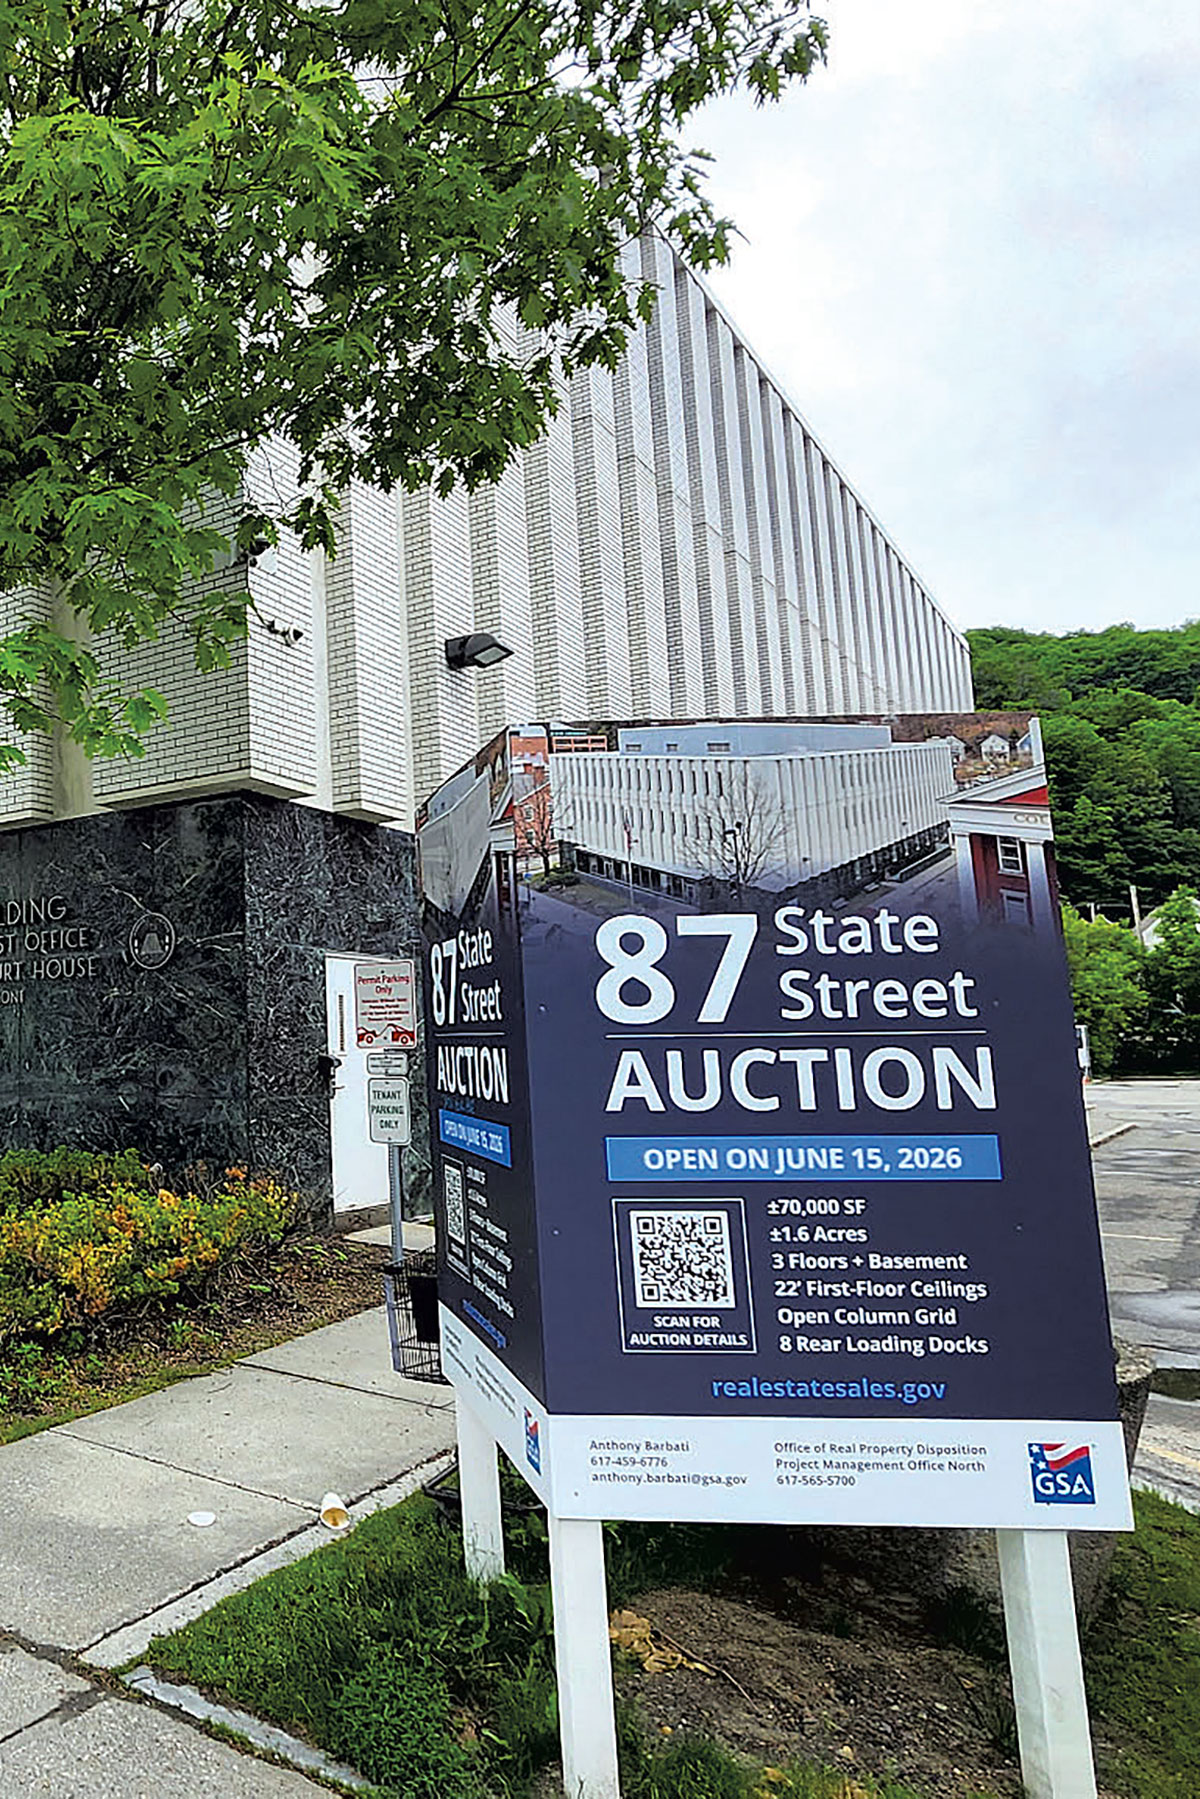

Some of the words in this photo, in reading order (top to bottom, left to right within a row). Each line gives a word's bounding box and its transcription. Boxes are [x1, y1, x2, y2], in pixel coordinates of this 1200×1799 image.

[25, 927, 90, 952] OFFICE
[773, 905, 940, 955] State
[457, 926, 493, 970] State
[32, 956, 98, 980] HOUSE
[595, 912, 759, 1025] 87
[357, 975, 381, 985] Permit
[382, 974, 410, 985] Parking
[430, 937, 458, 1027] 87
[375, 985, 393, 996] Only
[460, 979, 503, 1023] Street
[778, 969, 979, 1020] Street
[436, 1045, 510, 1104] AUCTION
[604, 1045, 998, 1112] AUCTION
[372, 1089, 402, 1100] TENANT
[371, 1105, 404, 1115] PARKING
[379, 1119, 399, 1129] ONLY
[643, 1148, 718, 1171] OPEN
[726, 1148, 770, 1171] ON
[774, 1148, 844, 1175] JUNE
[852, 1148, 891, 1174] 15,
[896, 1147, 963, 1170] 2026
[766, 1198, 841, 1219] ±70,000
[843, 1198, 867, 1216] SF
[768, 1225, 810, 1243] ±1.6
[812, 1225, 869, 1243] Acres
[771, 1252, 785, 1270] 3
[788, 1252, 849, 1270] Floors
[851, 1255, 865, 1269] +
[868, 1252, 968, 1270] Basement
[806, 1279, 906, 1299] First-Floor
[909, 1279, 988, 1301] Ceilings
[653, 1316, 691, 1329] SCAN
[693, 1316, 721, 1329] FOR
[777, 1307, 830, 1329] Open
[834, 1306, 911, 1325] Column
[914, 1306, 958, 1326] Grid
[629, 1333, 692, 1347] AUCTION
[693, 1333, 749, 1347] DETAILS
[779, 1335, 792, 1353] 8
[796, 1335, 843, 1353] Rear
[846, 1334, 926, 1357] Loading
[929, 1335, 990, 1354] Docks
[711, 1377, 947, 1404] realestatesales.gov
[588, 1440, 641, 1453] Anthony
[644, 1440, 690, 1452] Barbati
[774, 1442, 811, 1454] Office
[813, 1442, 827, 1454] of
[829, 1443, 856, 1454] Real
[858, 1443, 913, 1457] Property
[916, 1443, 987, 1457] Disposition
[590, 1456, 669, 1468] 617-459-6776
[775, 1458, 819, 1472] Project
[822, 1459, 904, 1473] Management
[907, 1459, 945, 1471] Office
[948, 1460, 986, 1472] North
[591, 1472, 747, 1487] anthony.barbati@gsa.gov
[776, 1475, 857, 1487] 617-565-5700
[1034, 1471, 1093, 1496] GSA
